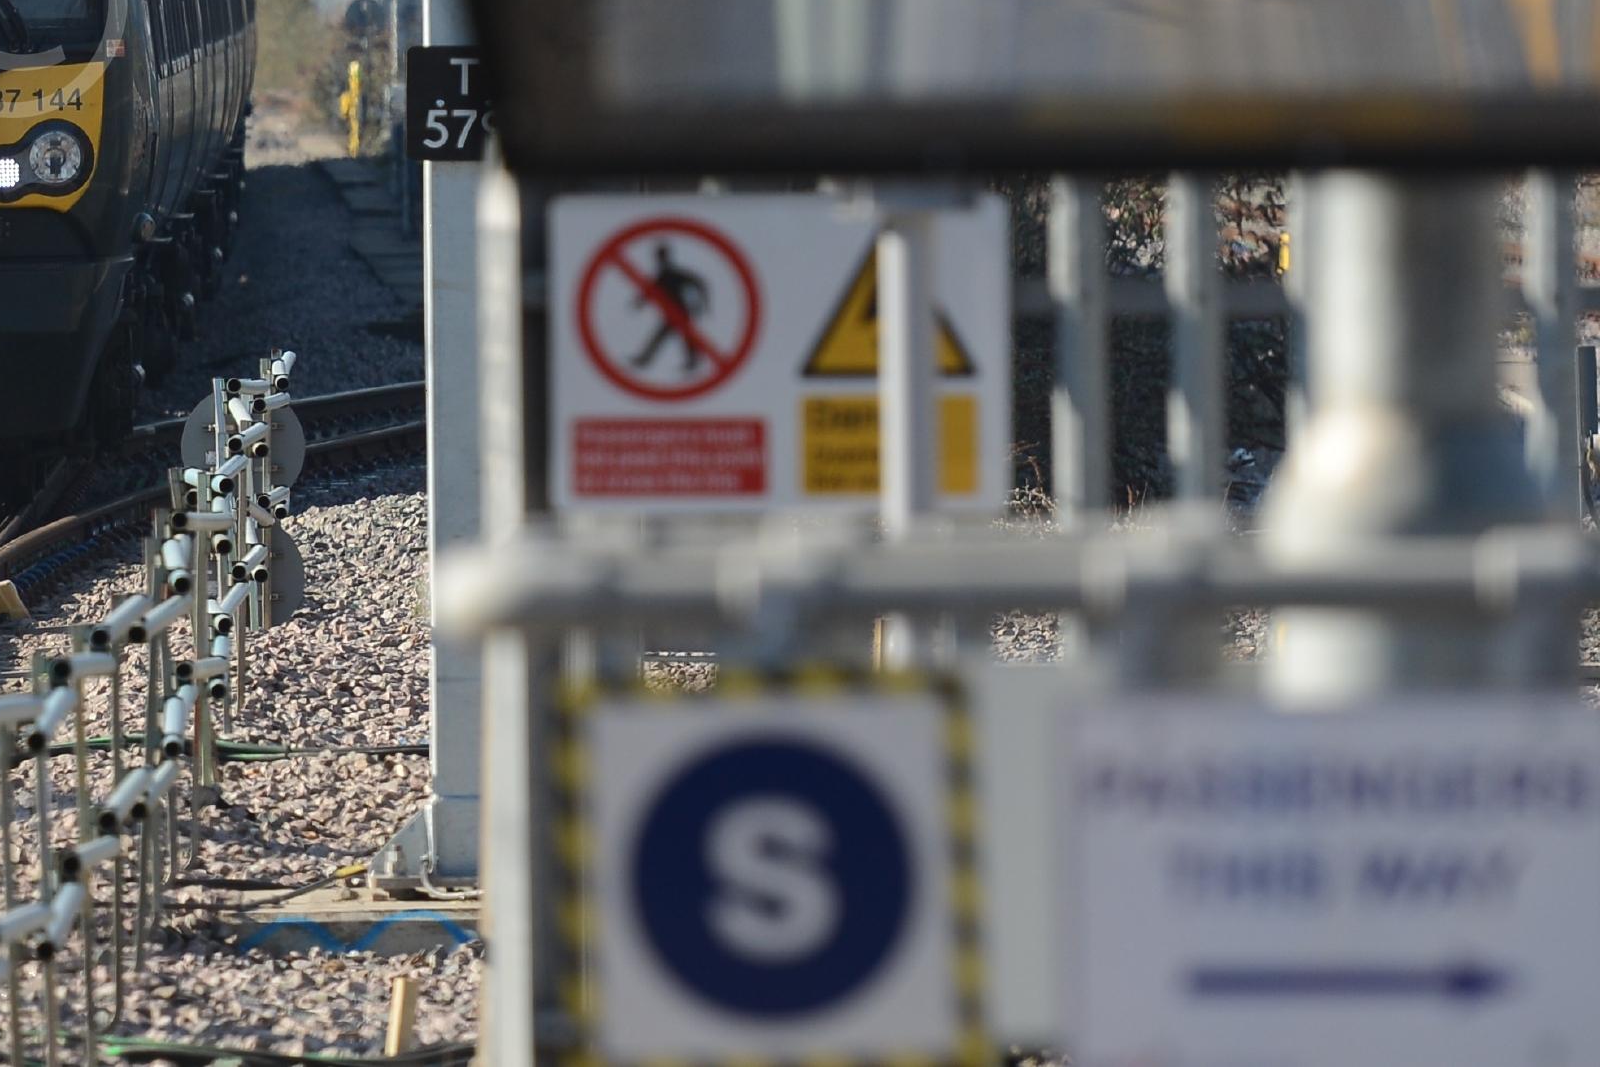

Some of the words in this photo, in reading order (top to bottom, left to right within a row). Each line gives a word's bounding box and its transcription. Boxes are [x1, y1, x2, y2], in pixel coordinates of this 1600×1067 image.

[449, 58, 480, 96] T
[31, 87, 84, 112] 144
[707, 797, 842, 966] S
